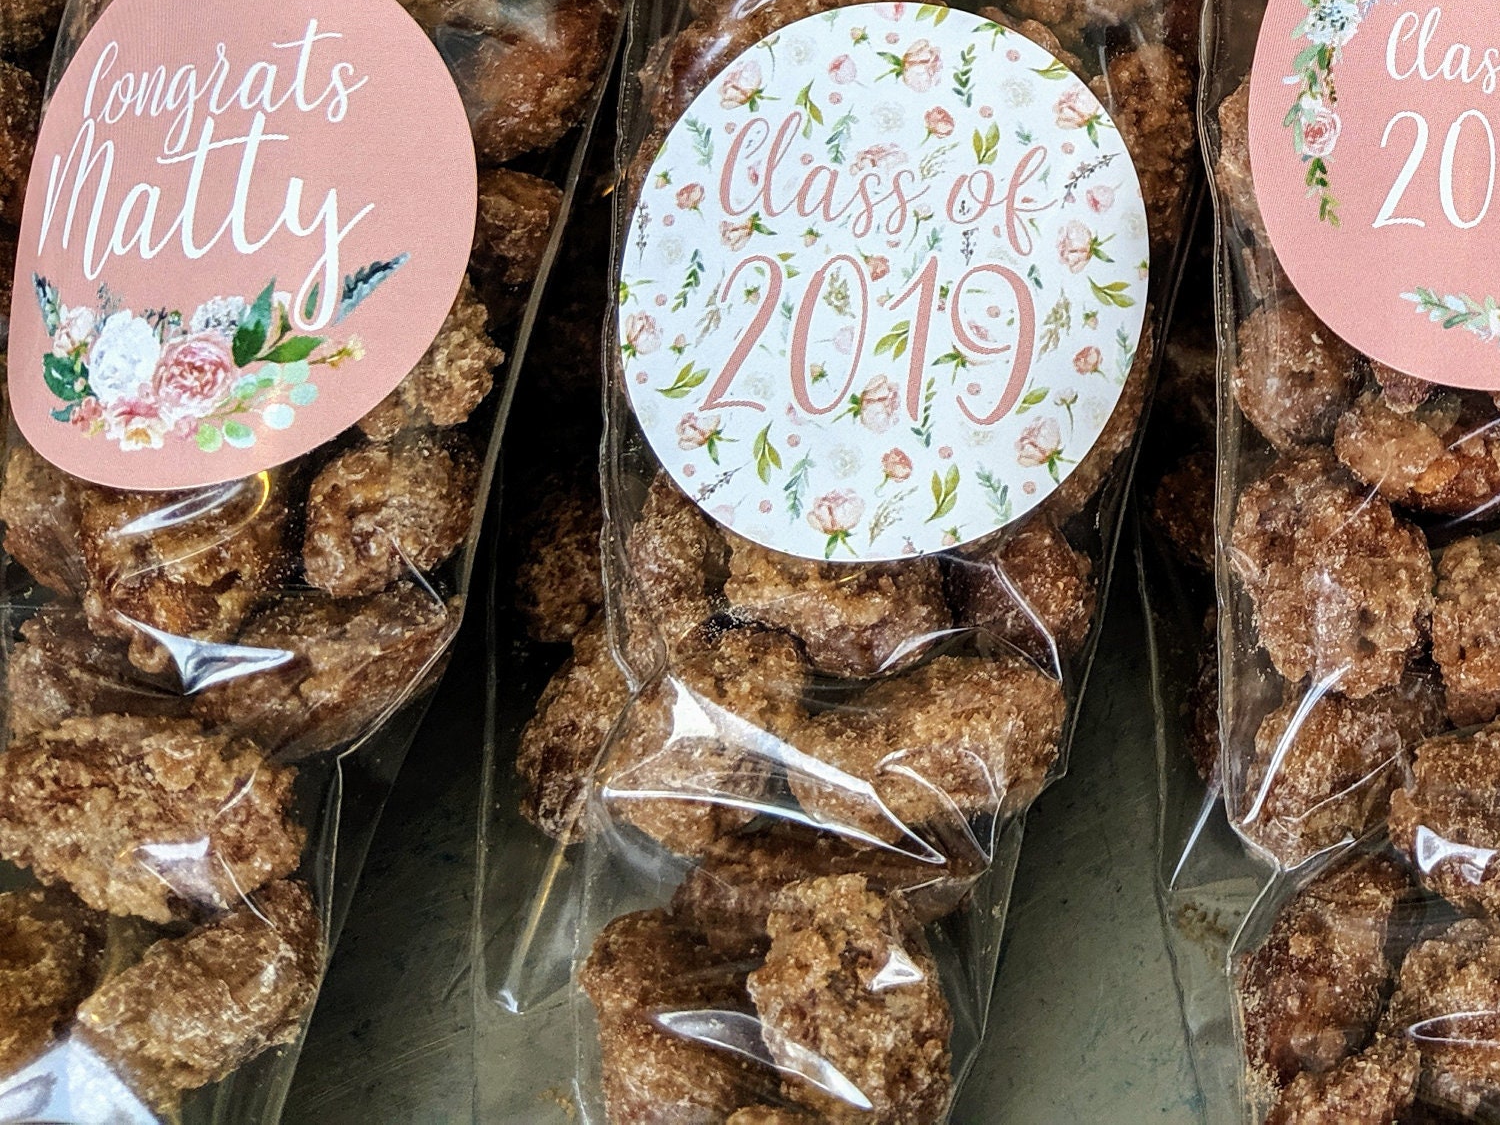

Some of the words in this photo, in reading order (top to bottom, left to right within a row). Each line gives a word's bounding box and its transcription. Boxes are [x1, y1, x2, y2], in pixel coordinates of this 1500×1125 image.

[83, 18, 369, 155] Congrats
[37, 110, 376, 332] Matty
[719, 111, 931, 238] Class
[947, 146, 1058, 256] of
[698, 254, 1037, 426] 2019
